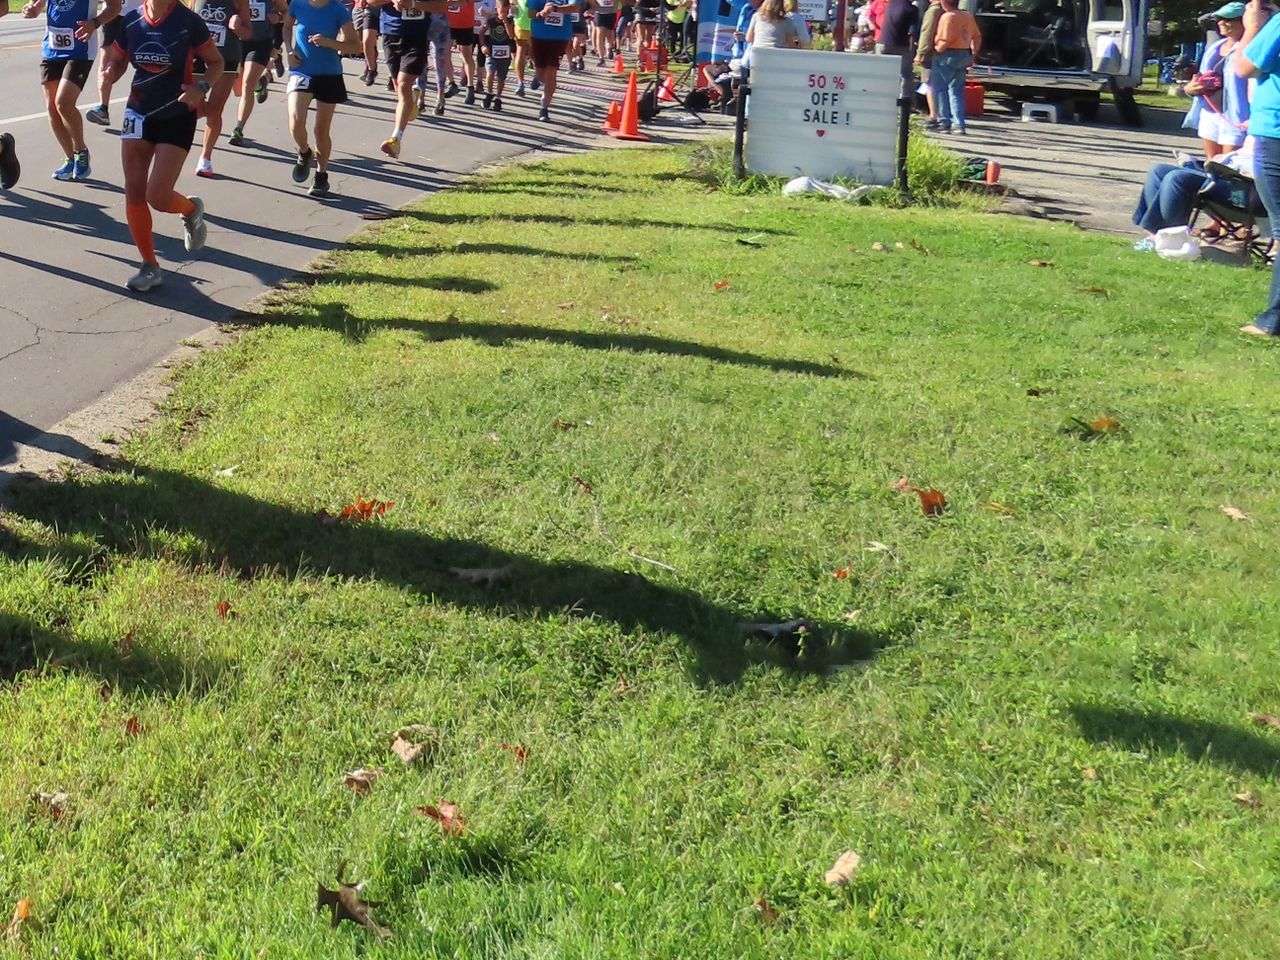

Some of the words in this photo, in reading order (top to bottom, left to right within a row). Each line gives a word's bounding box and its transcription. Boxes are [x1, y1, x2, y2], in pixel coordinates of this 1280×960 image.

[808, 74, 826, 88] 50
[832, 76, 845, 90] %
[811, 91, 839, 106] OFF
[802, 108, 839, 125] SALE
